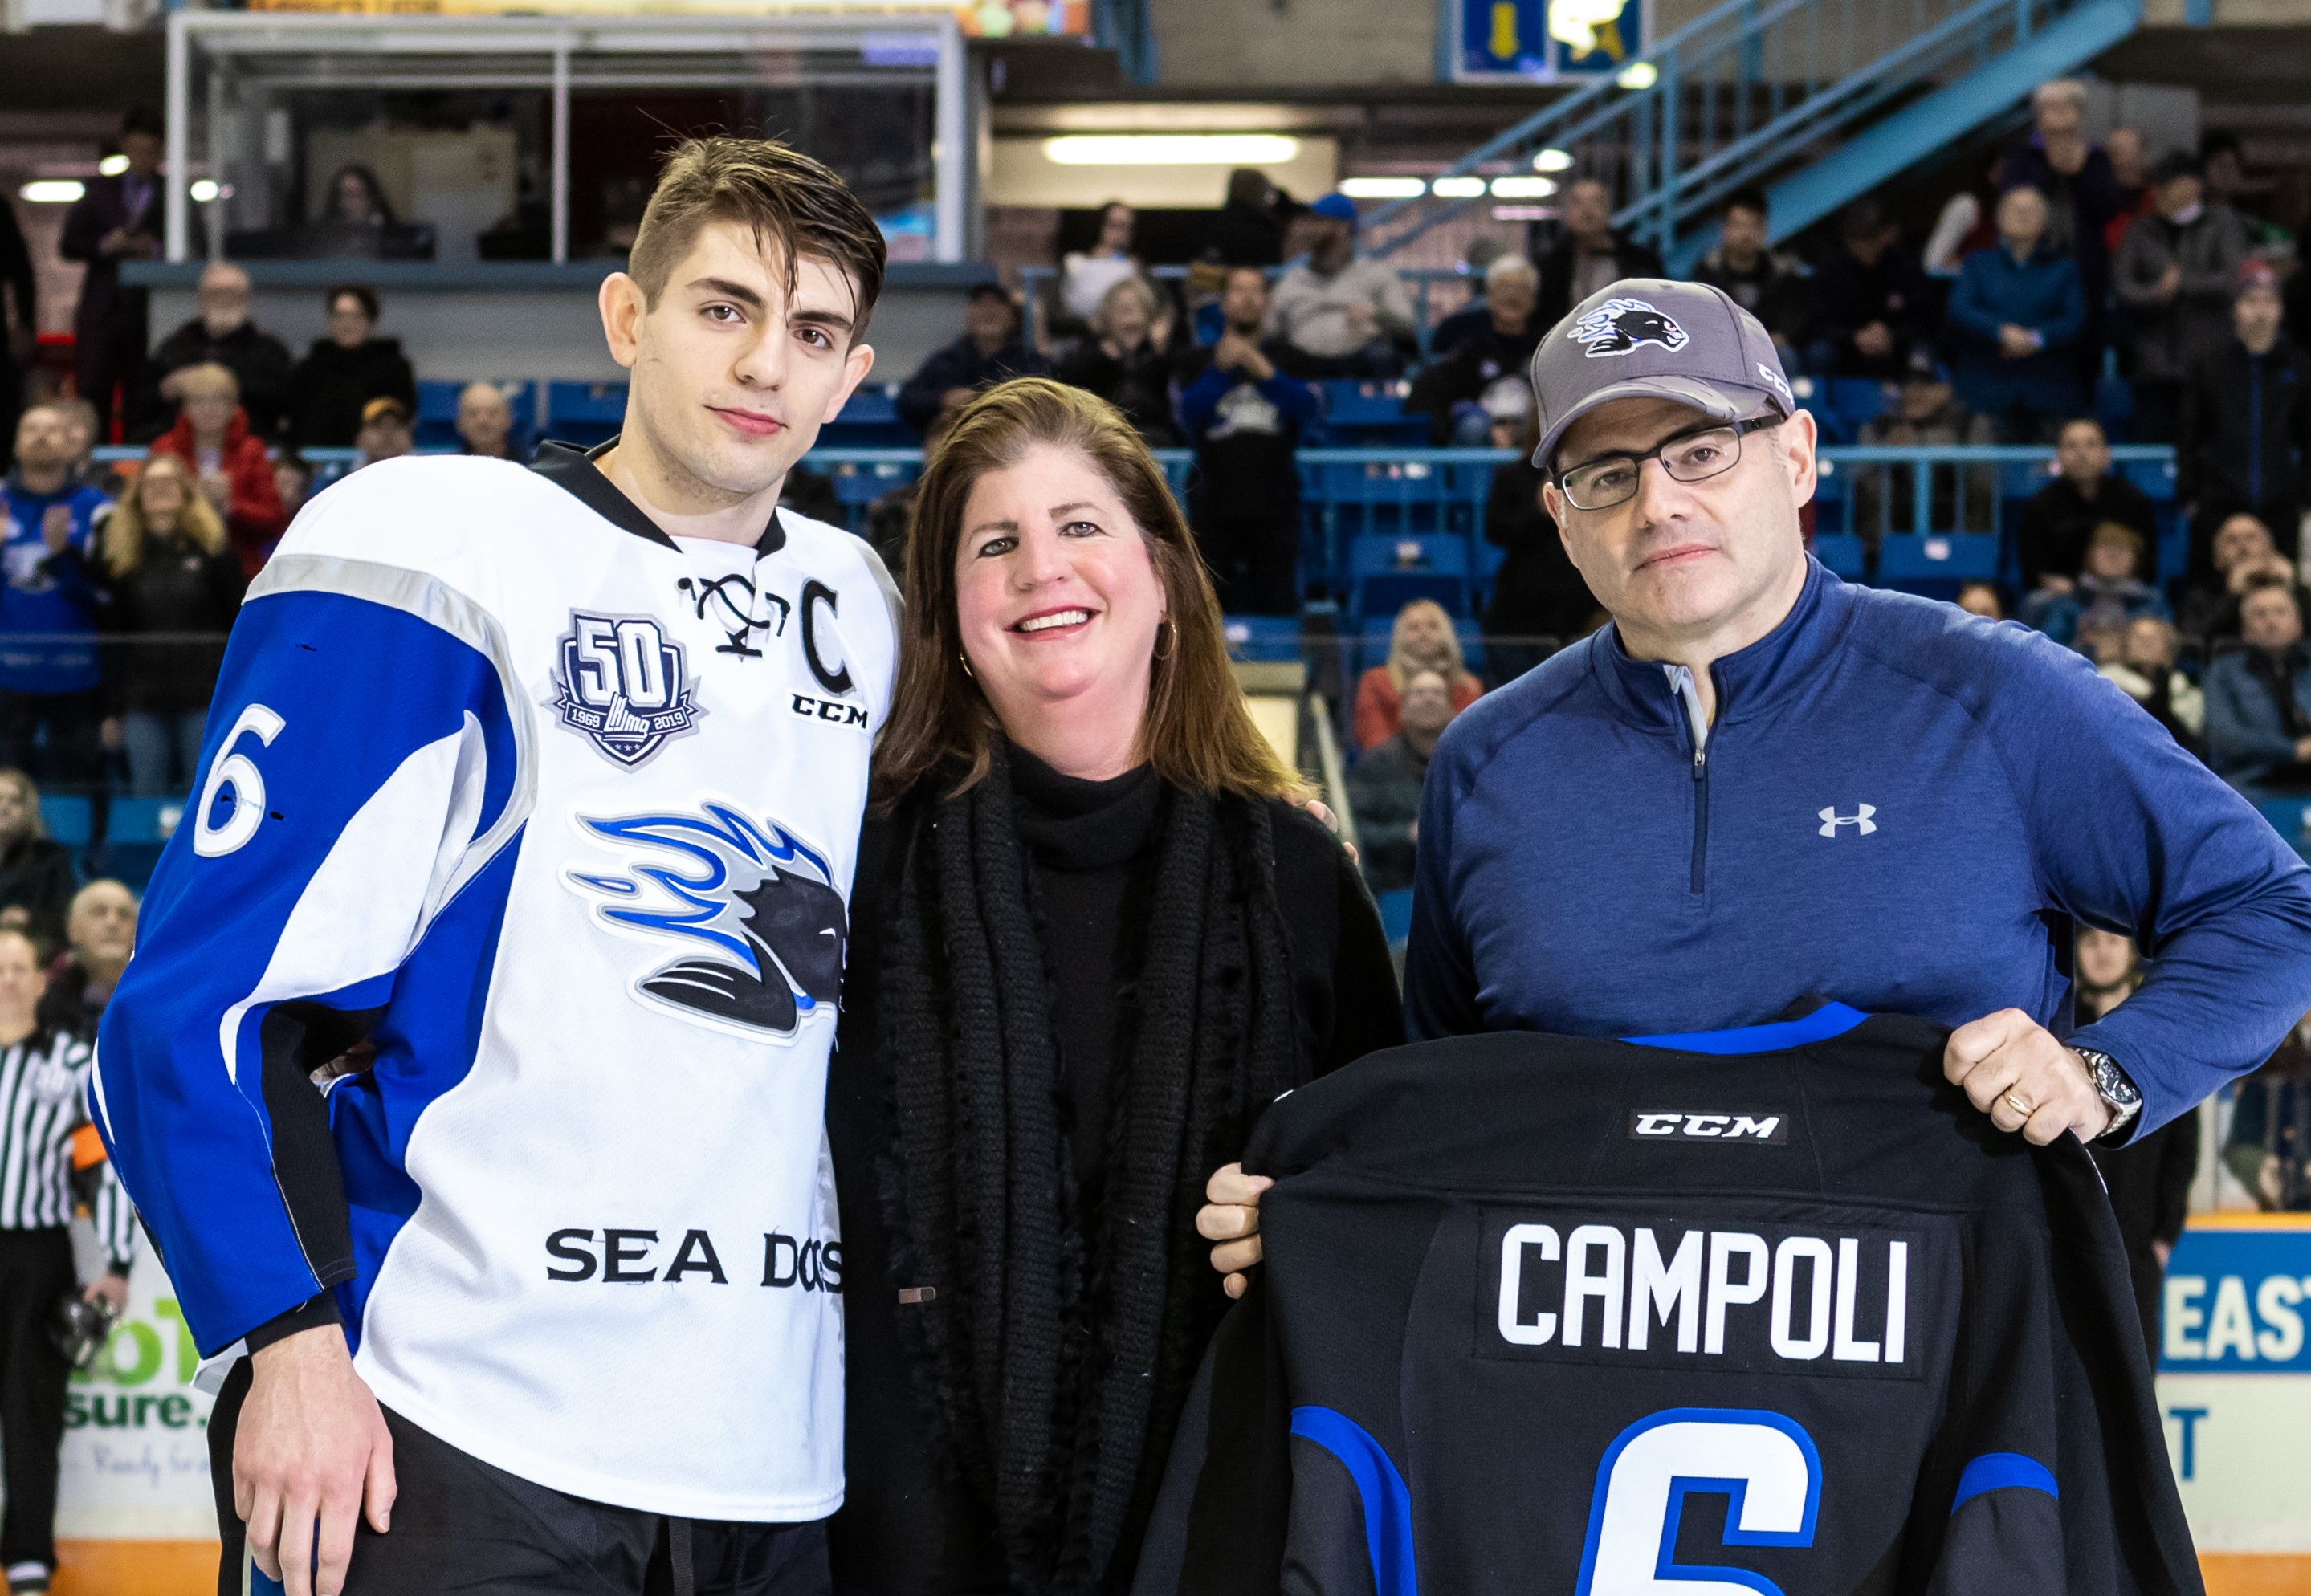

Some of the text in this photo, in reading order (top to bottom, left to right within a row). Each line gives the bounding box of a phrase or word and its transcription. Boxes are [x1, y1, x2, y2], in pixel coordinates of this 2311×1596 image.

[576, 617, 667, 708] 50
[799, 576, 857, 698] C
[571, 708, 601, 728] 1969
[653, 711, 684, 731] 2019
[791, 693, 868, 729] CCM
[194, 703, 286, 857] 6
[1635, 1114, 1779, 1138] CCM
[546, 1228, 728, 1285] SEA
[1498, 1223, 1908, 1363] CAMPOLI
[2164, 1274, 2311, 1362] EAS
